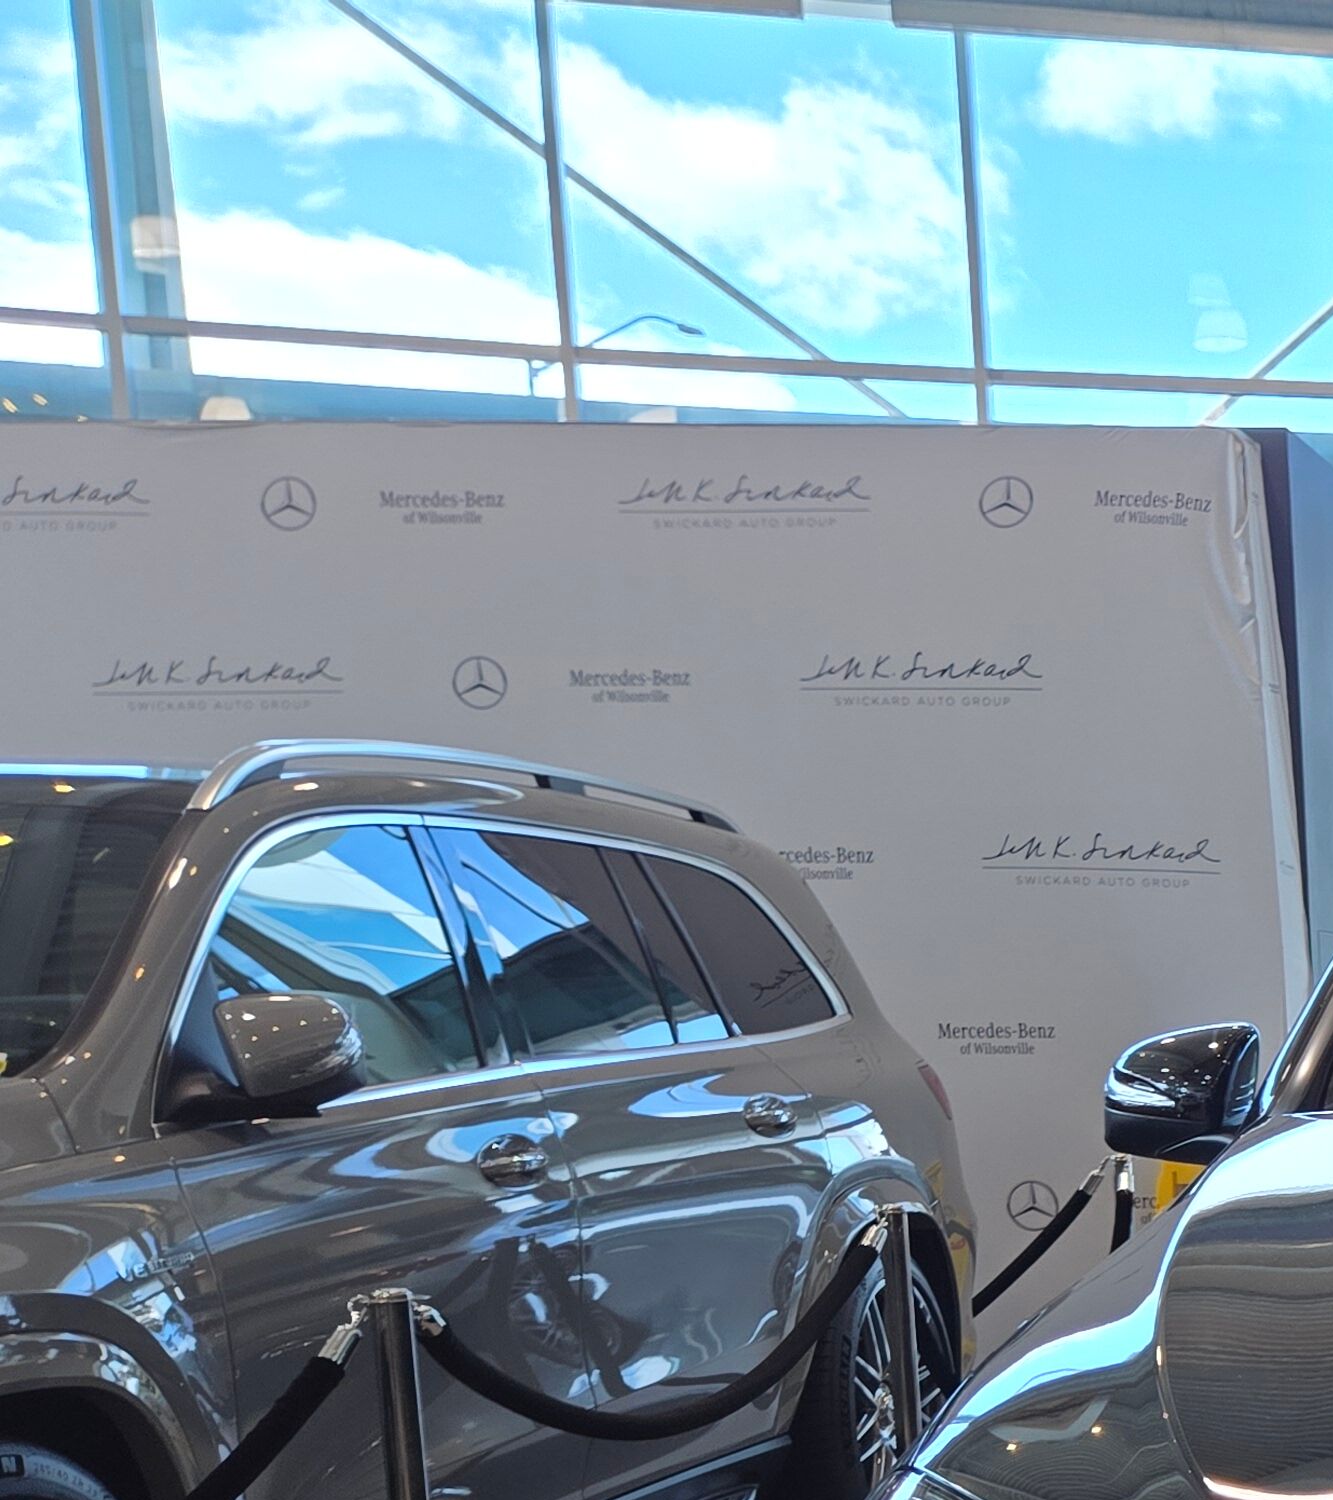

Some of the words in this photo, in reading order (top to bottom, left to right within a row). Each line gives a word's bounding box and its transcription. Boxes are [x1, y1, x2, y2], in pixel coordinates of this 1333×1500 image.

[380, 490, 505, 509] Mercedes-Benz
[1094, 490, 1212, 513] Mercedes-Benz
[402, 511, 416, 525] of
[1113, 510, 1127, 524] of
[1128, 510, 1189, 527] Wilsonville
[568, 668, 691, 687] Mercedes-Benz
[917, 696, 956, 707] AUTO
[961, 696, 1012, 707] GROUP
[1015, 875, 1092, 887] SWICKARD
[1098, 876, 1136, 888] AUTO
[1141, 877, 1191, 889] GROUP
[937, 1022, 1056, 1040] Mercedes-Benz
[960, 1042, 972, 1055] of
[973, 1042, 1036, 1055] Wilsonville
